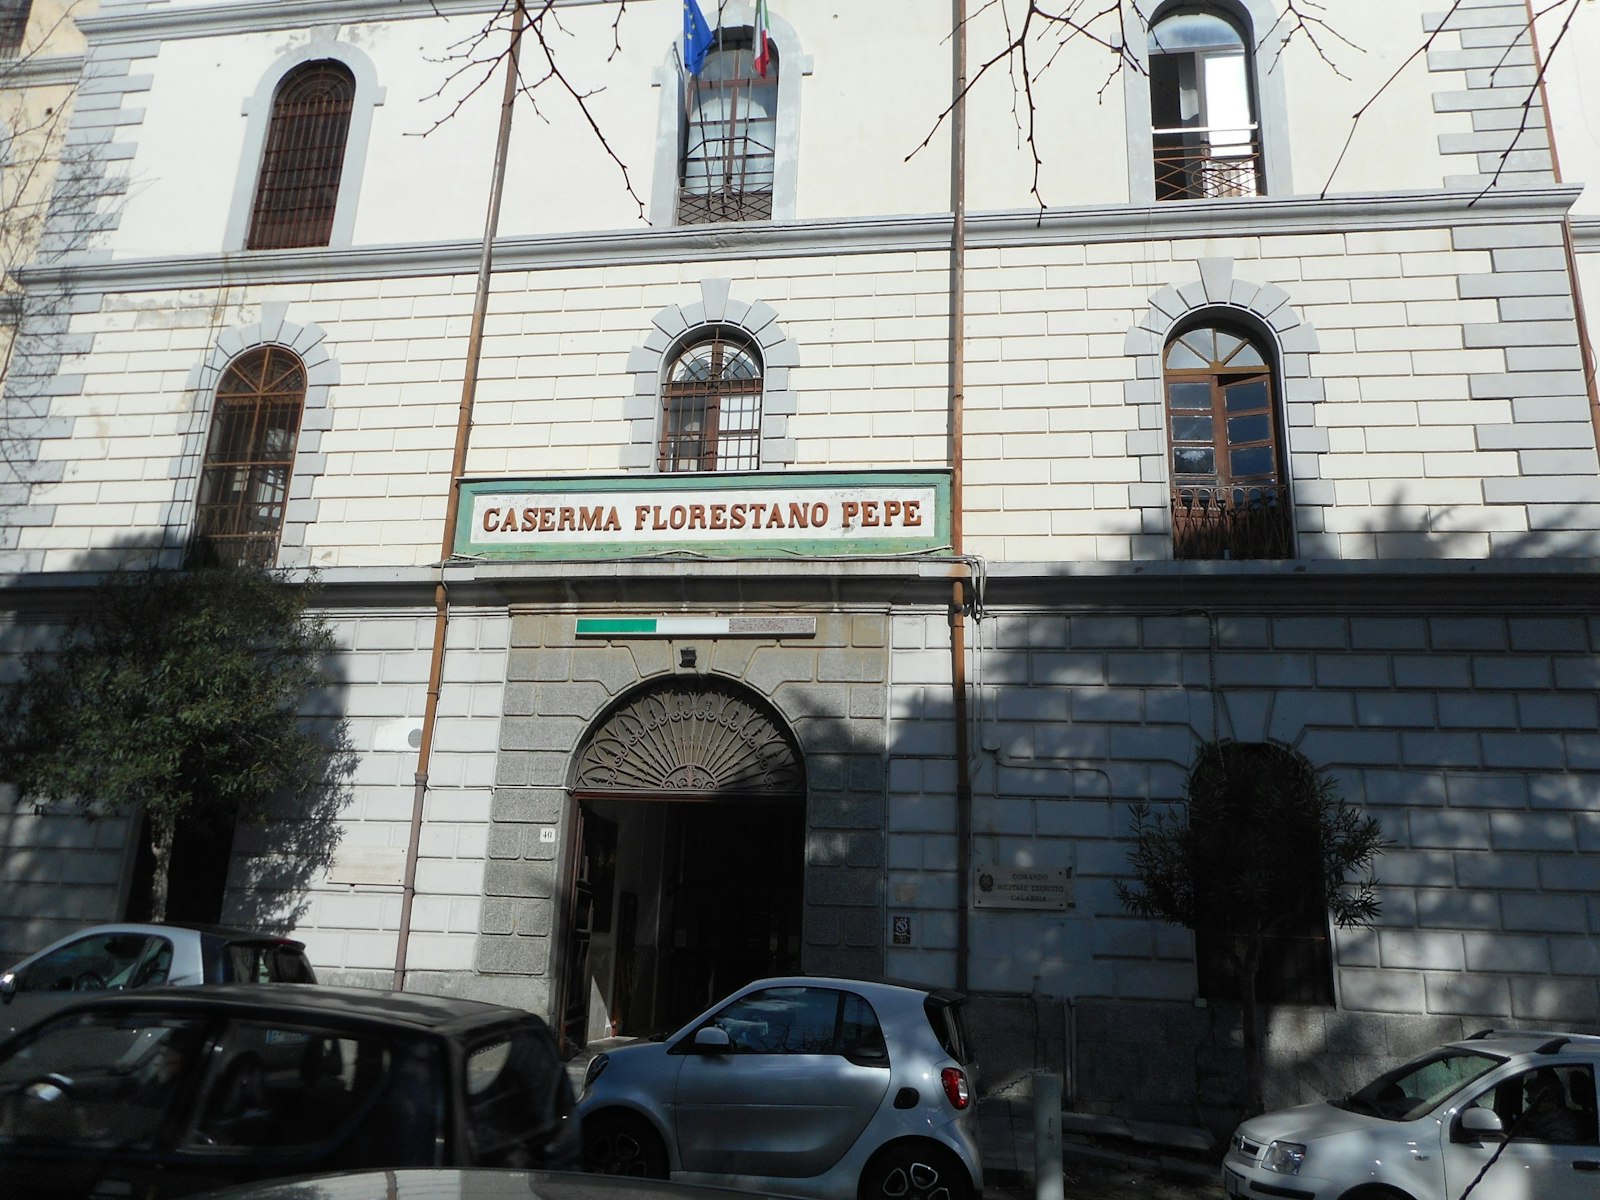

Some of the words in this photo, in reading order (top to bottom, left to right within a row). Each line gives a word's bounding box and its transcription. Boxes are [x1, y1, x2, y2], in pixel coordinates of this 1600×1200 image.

[483, 506, 622, 532] CASERMA
[634, 502, 829, 531] FLORESTANO
[841, 500, 922, 528] PEPE
[1012, 873, 1049, 881] COMANDO
[997, 884, 1030, 892] MILITARE
[1031, 885, 1065, 893] ESERCITO
